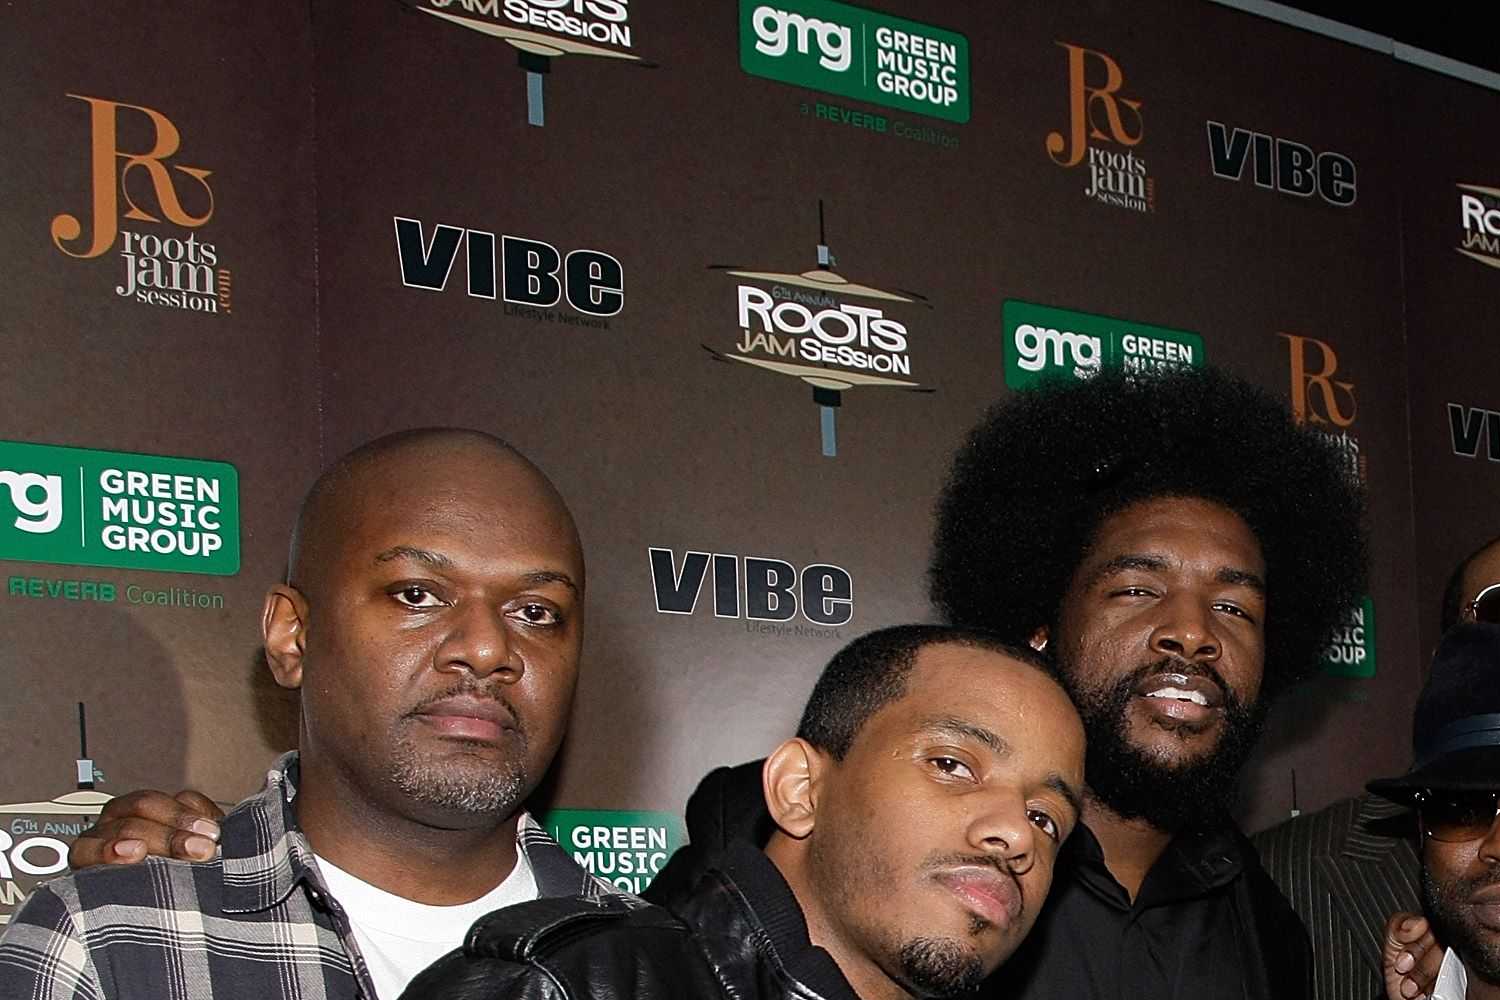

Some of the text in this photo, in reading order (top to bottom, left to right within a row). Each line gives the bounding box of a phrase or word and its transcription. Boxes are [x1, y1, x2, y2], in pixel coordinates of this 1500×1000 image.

[503, 1, 632, 47] SESSION
[752, 6, 851, 72] gmg
[876, 27, 957, 65] GREEN
[877, 48, 957, 86] MUSIC
[876, 72, 958, 106] GROUP
[815, 103, 887, 132] REVERB
[893, 122, 960, 148] Coalition
[1089, 147, 1147, 176] roots
[1085, 164, 1147, 199] jam
[1097, 191, 1147, 212] session
[120, 230, 218, 267] roots
[1462, 229, 1500, 255] JAM
[116, 253, 218, 297] jam
[136, 288, 219, 314] session
[794, 291, 838, 308] ANNUAL
[503, 305, 611, 331] Lifestyle Network
[738, 285, 908, 352] ROOTS
[736, 330, 911, 375] JAM SESSION
[1015, 324, 1101, 380] gmg
[1122, 334, 1193, 364] GREEN
[100, 469, 220, 504] GREEN
[102, 496, 221, 531] MUSIC
[101, 525, 223, 557] GROUP
[9, 576, 225, 610] REVERB Coalition
[745, 621, 842, 640] Lifestyle Network
[1328, 644, 1367, 665] OUP
[572, 826, 667, 849] GREEN
